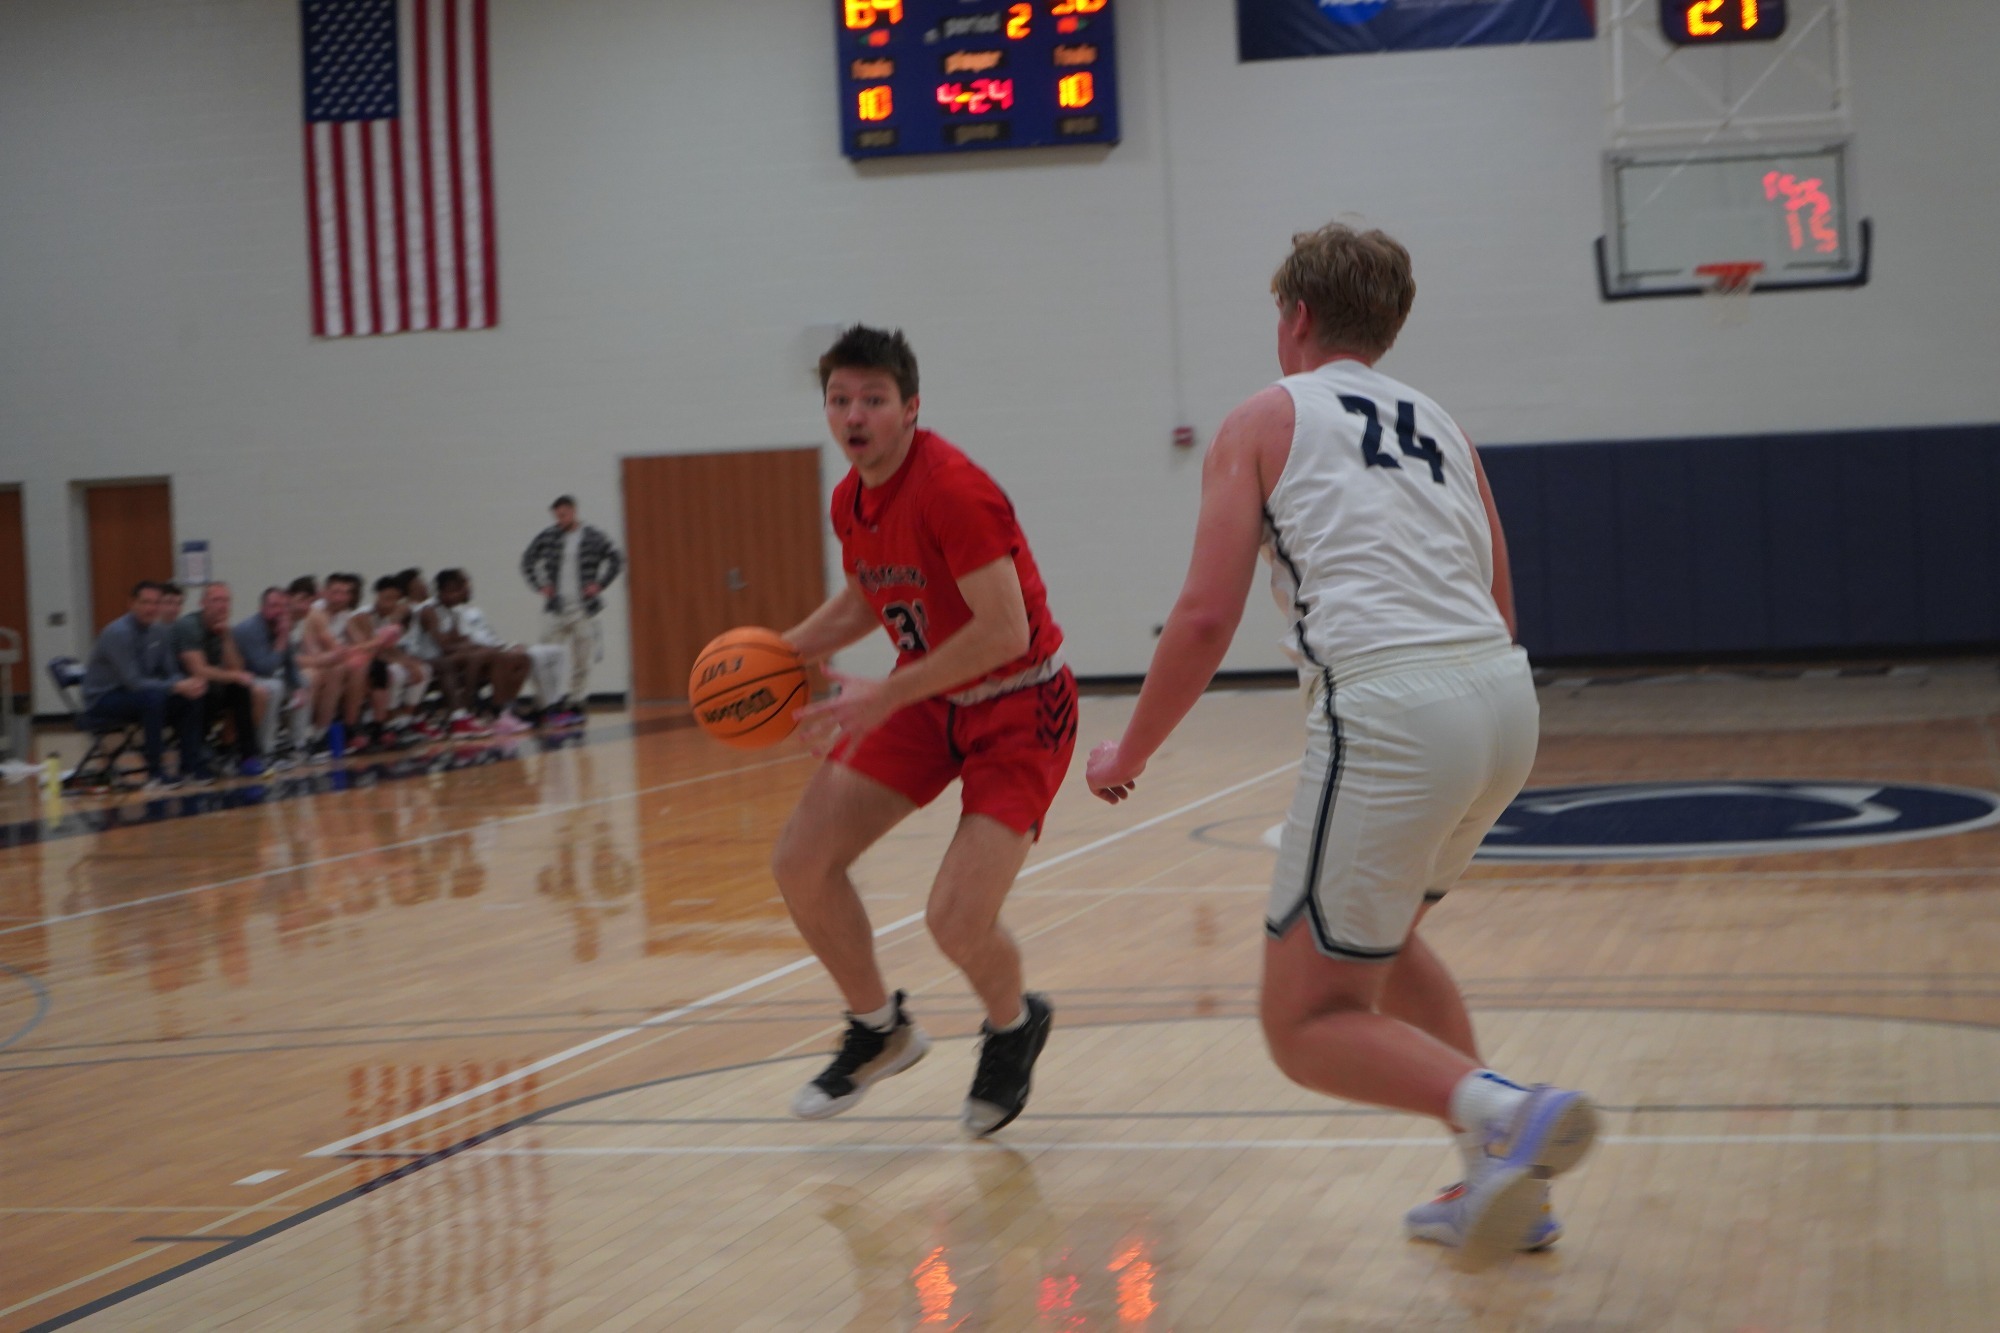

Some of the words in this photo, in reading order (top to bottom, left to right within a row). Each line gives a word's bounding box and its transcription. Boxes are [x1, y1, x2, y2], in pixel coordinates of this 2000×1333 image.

[1006, 2, 1032, 39] 2
[858, 85, 893, 120] 10
[1058, 71, 1094, 108] 10
[1336, 394, 1446, 485] 24
